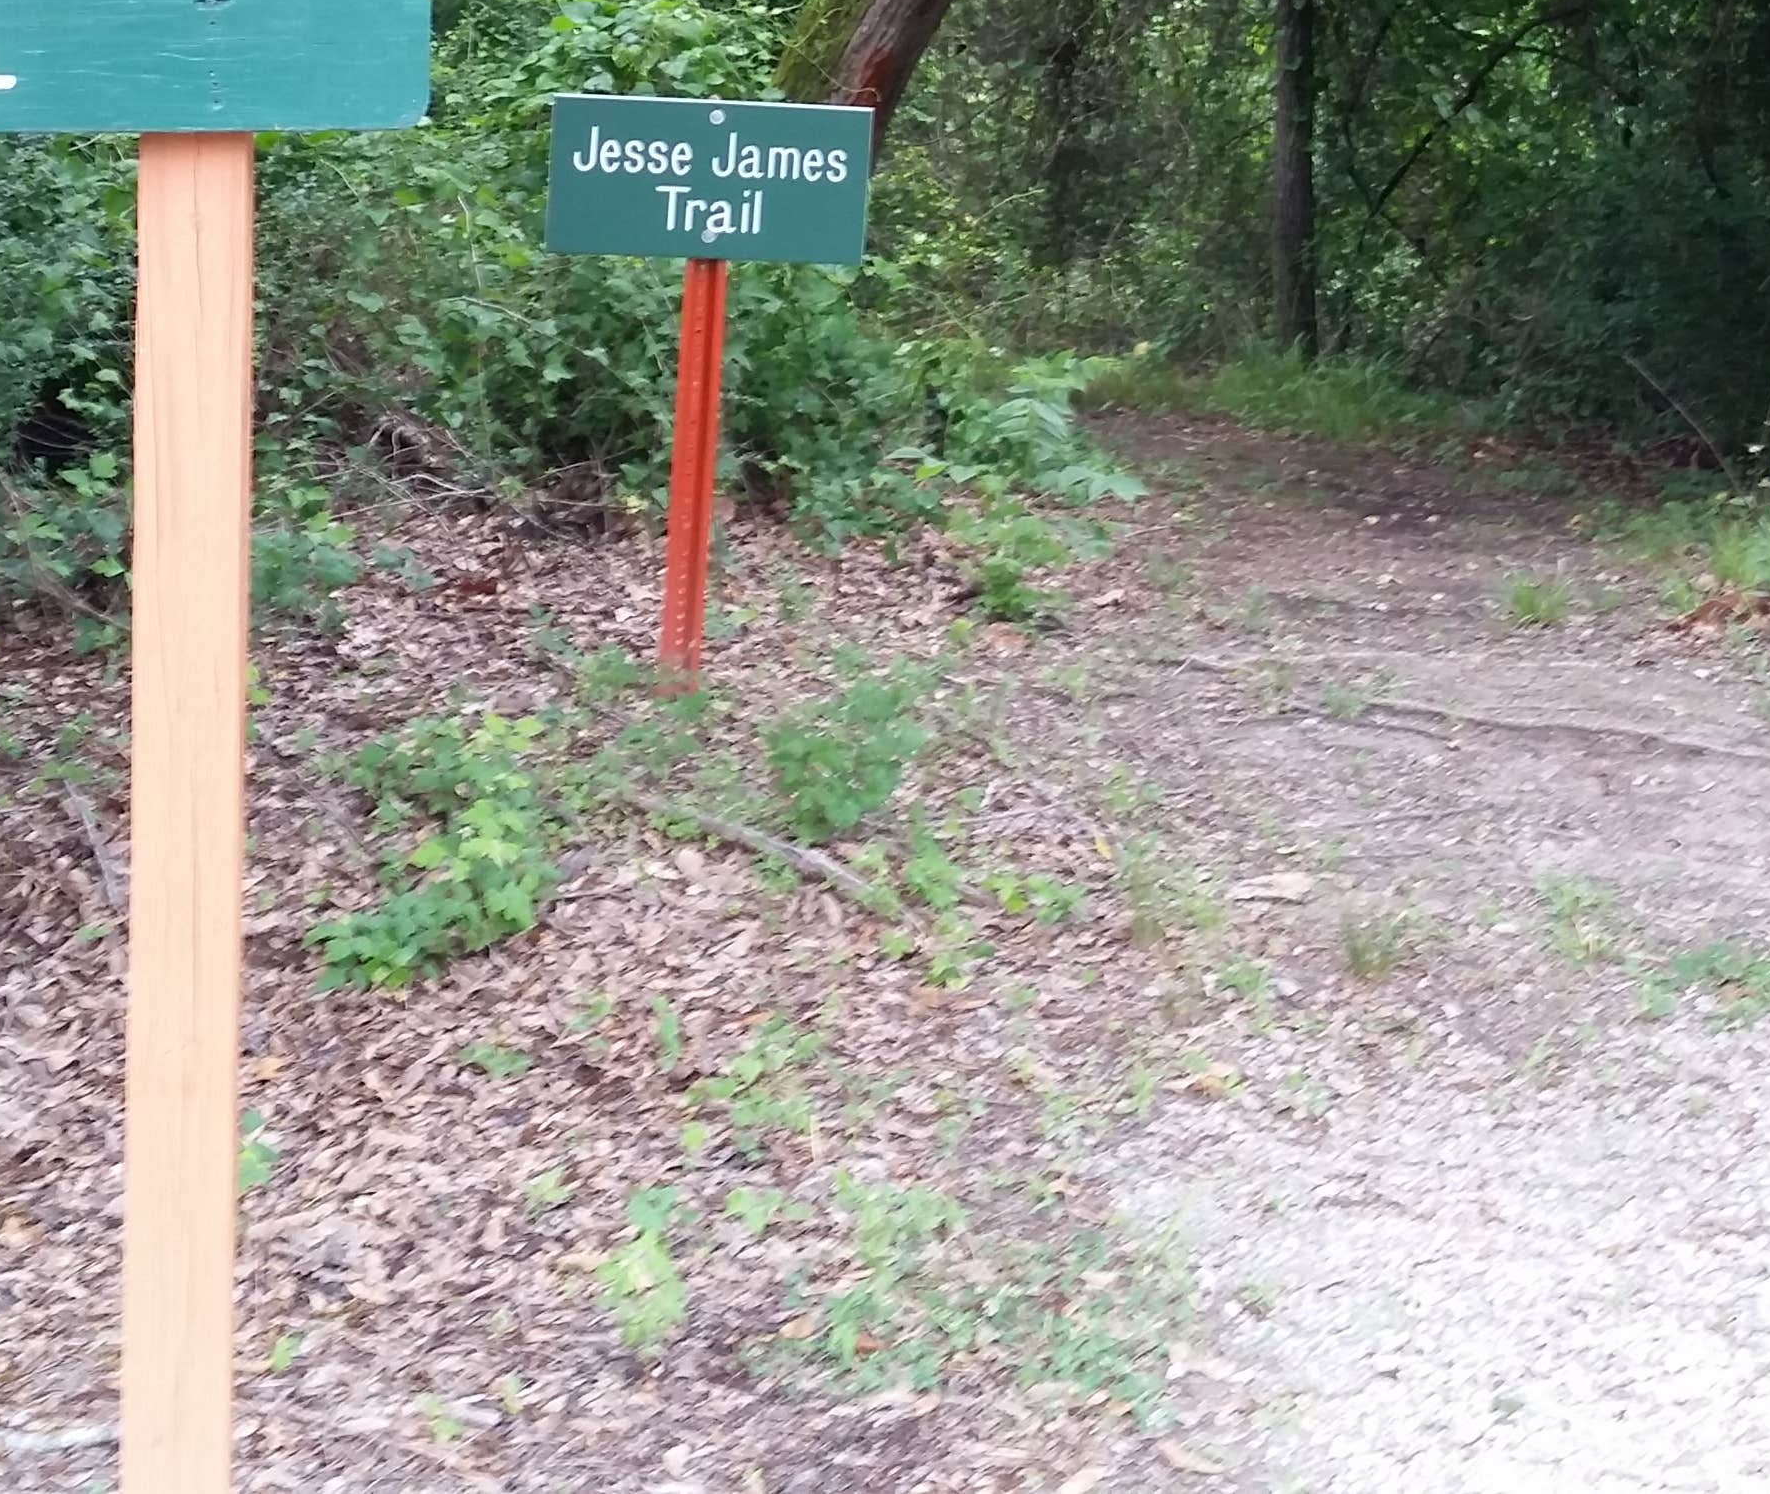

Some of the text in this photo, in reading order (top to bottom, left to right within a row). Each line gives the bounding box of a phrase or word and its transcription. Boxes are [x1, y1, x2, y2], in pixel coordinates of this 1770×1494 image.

[572, 125, 849, 183] Jesse James
[654, 185, 764, 235] Trail
